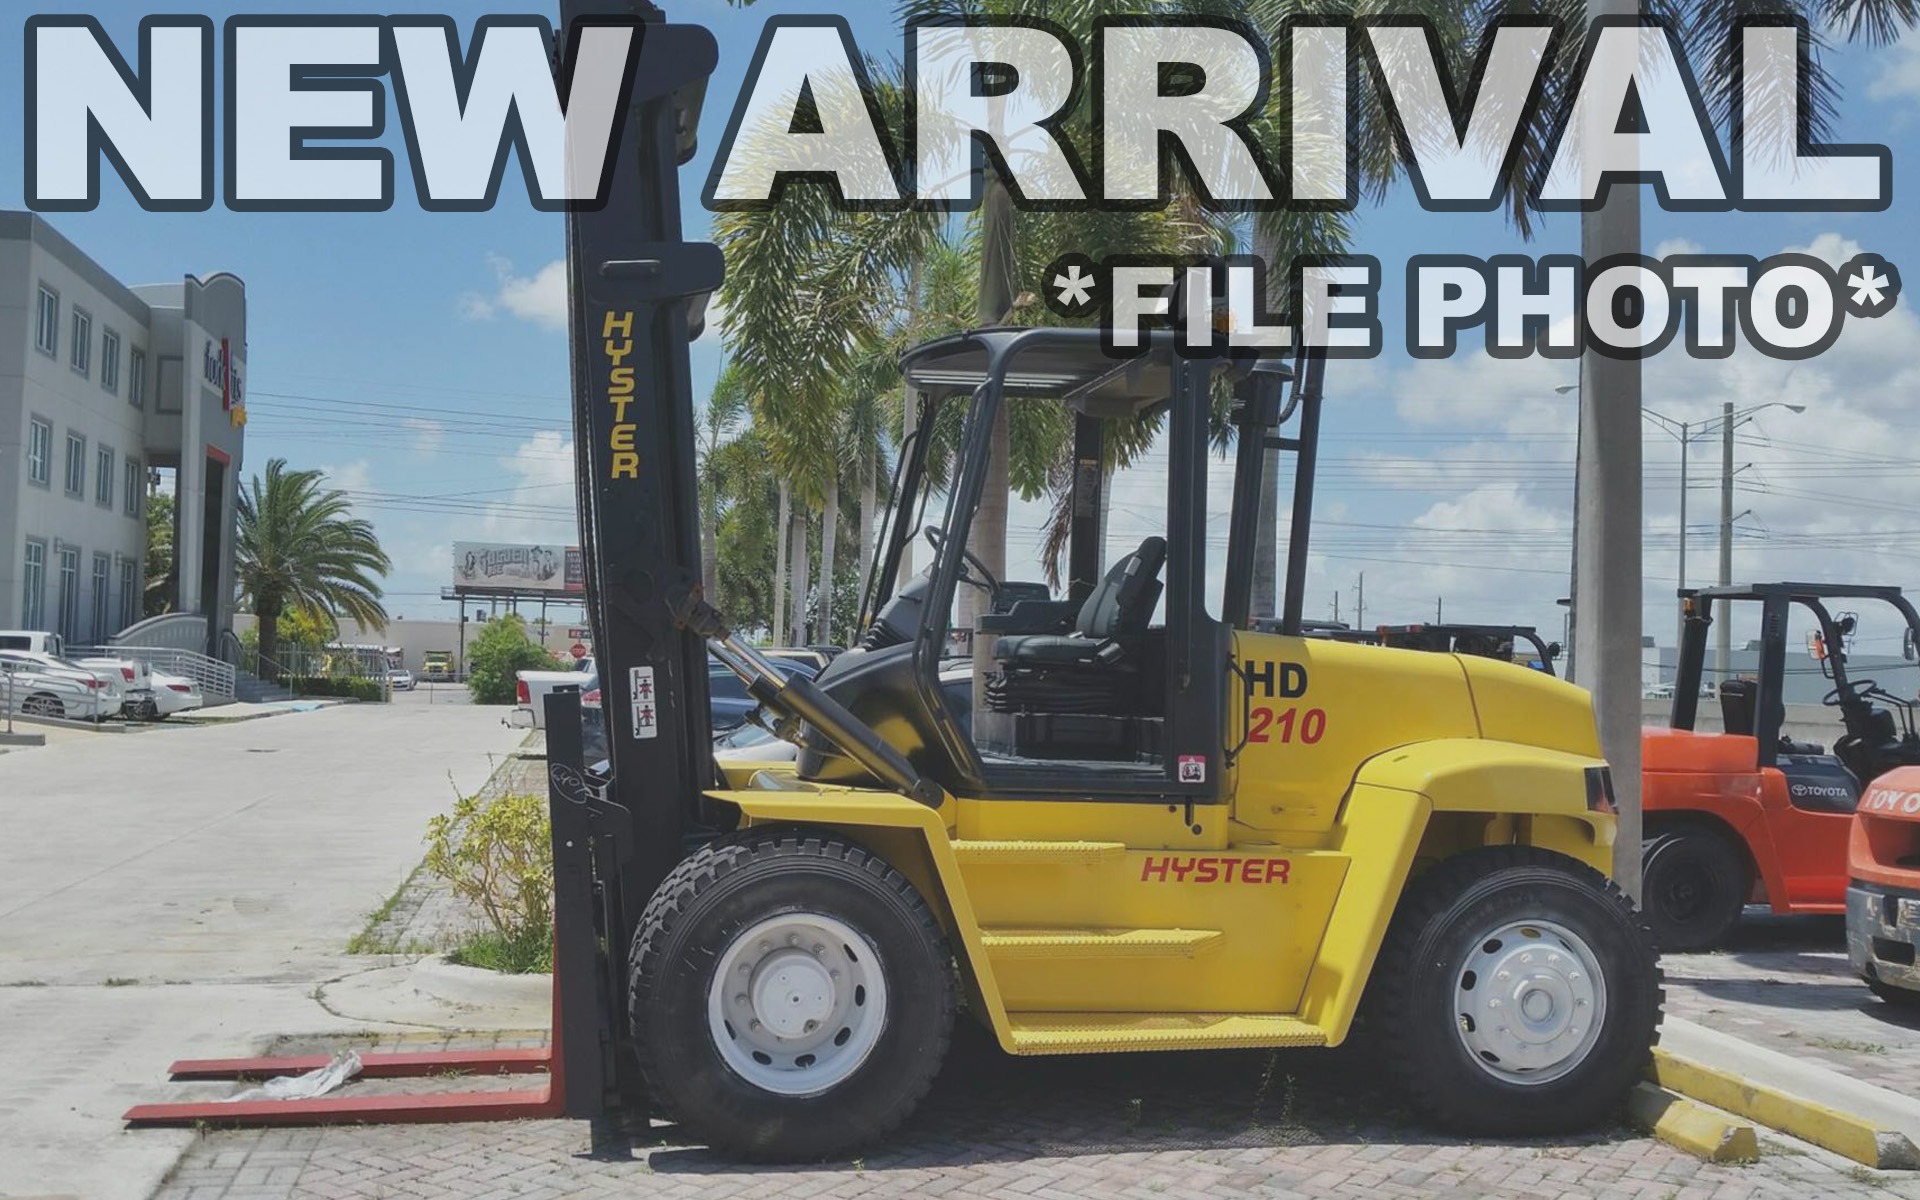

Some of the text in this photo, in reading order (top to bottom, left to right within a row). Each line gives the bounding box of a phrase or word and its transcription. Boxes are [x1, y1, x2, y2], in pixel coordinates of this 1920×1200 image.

[602, 310, 640, 479] HYSTER
[1244, 659, 1308, 699] HD
[1247, 706, 1327, 745] 210
[1807, 785, 1848, 797] TOYOTA
[1865, 788, 1920, 814] TOYO
[1140, 856, 1291, 884] HYSTER
